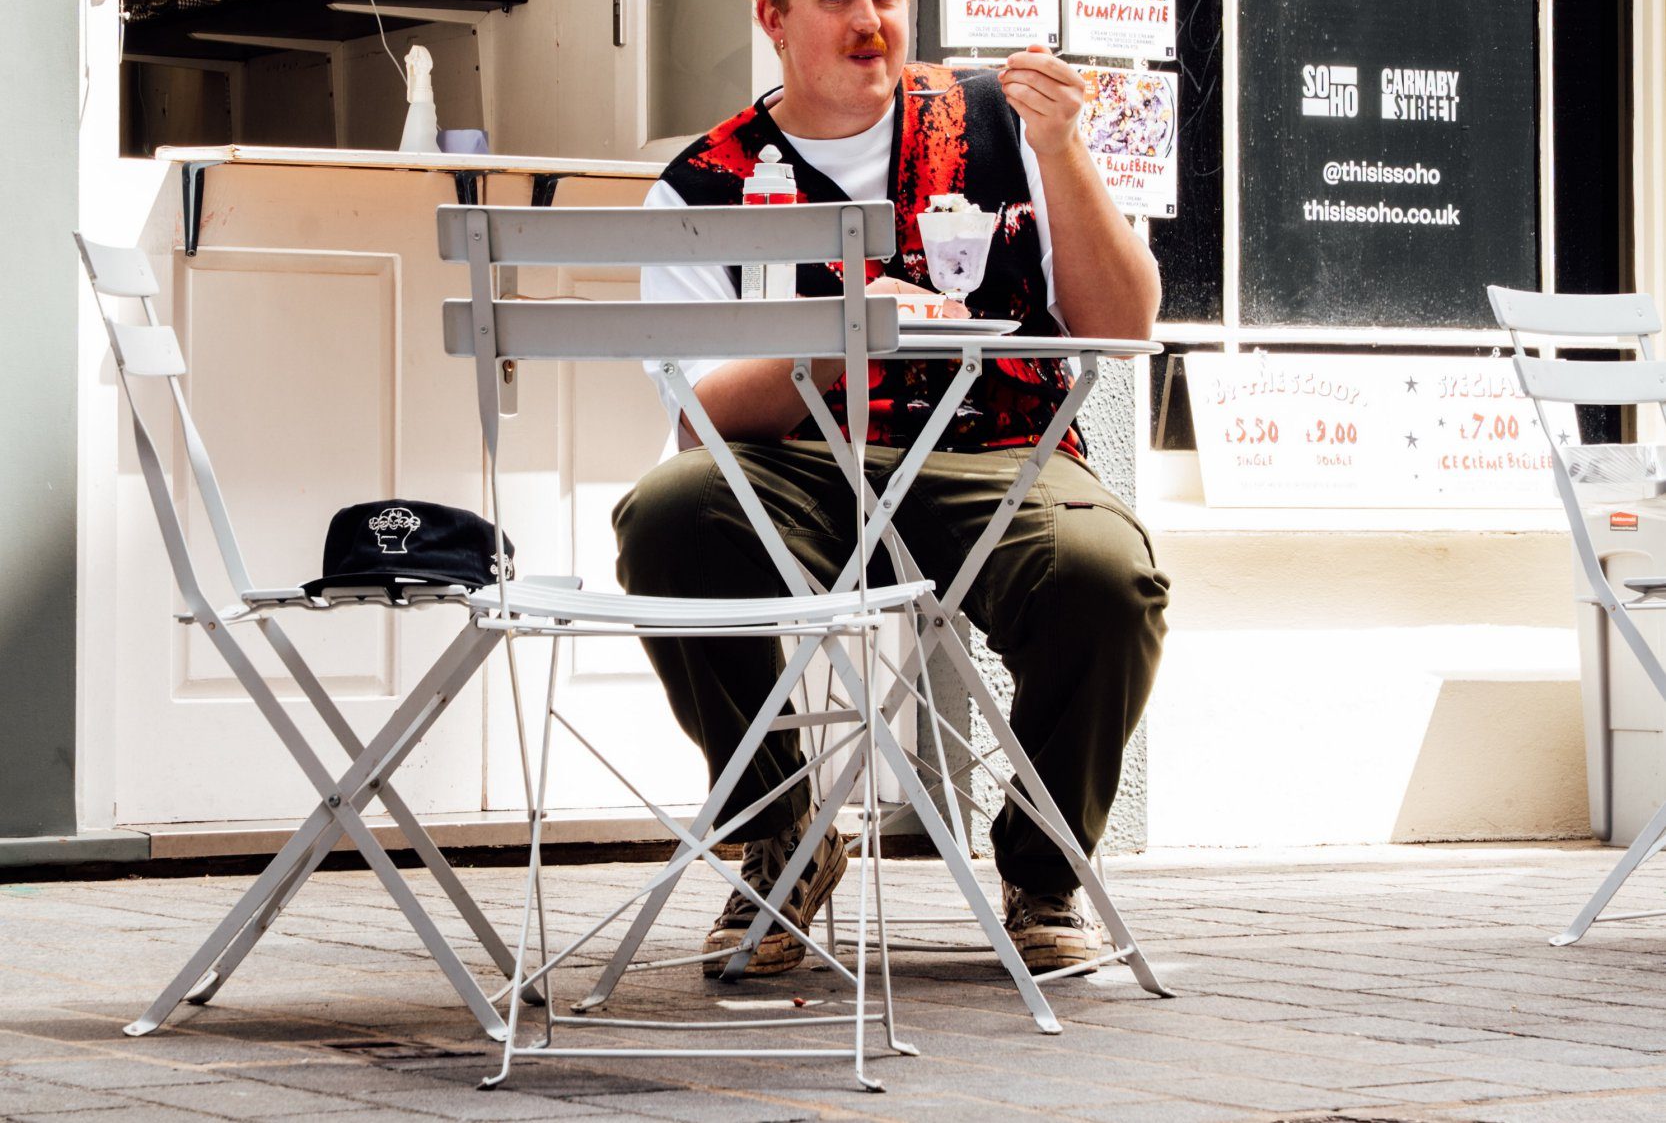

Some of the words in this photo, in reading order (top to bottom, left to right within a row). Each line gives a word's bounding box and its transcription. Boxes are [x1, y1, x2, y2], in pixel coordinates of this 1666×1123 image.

[966, 1, 1039, 18] BAKLAVA
[1076, 0, 1144, 23] PUMPKIN
[1148, 5, 1169, 23] PIE
[1382, 67, 1460, 97] CARNABY
[1394, 93, 1460, 121] STREET
[1106, 156, 1165, 176] BLUEBERRY
[1322, 161, 1441, 185] @thisissoho
[1302, 200, 1460, 225] thisissoho.co.uk
[1236, 453, 1273, 467] SINGLE
[1316, 453, 1353, 467] DOUBLE
